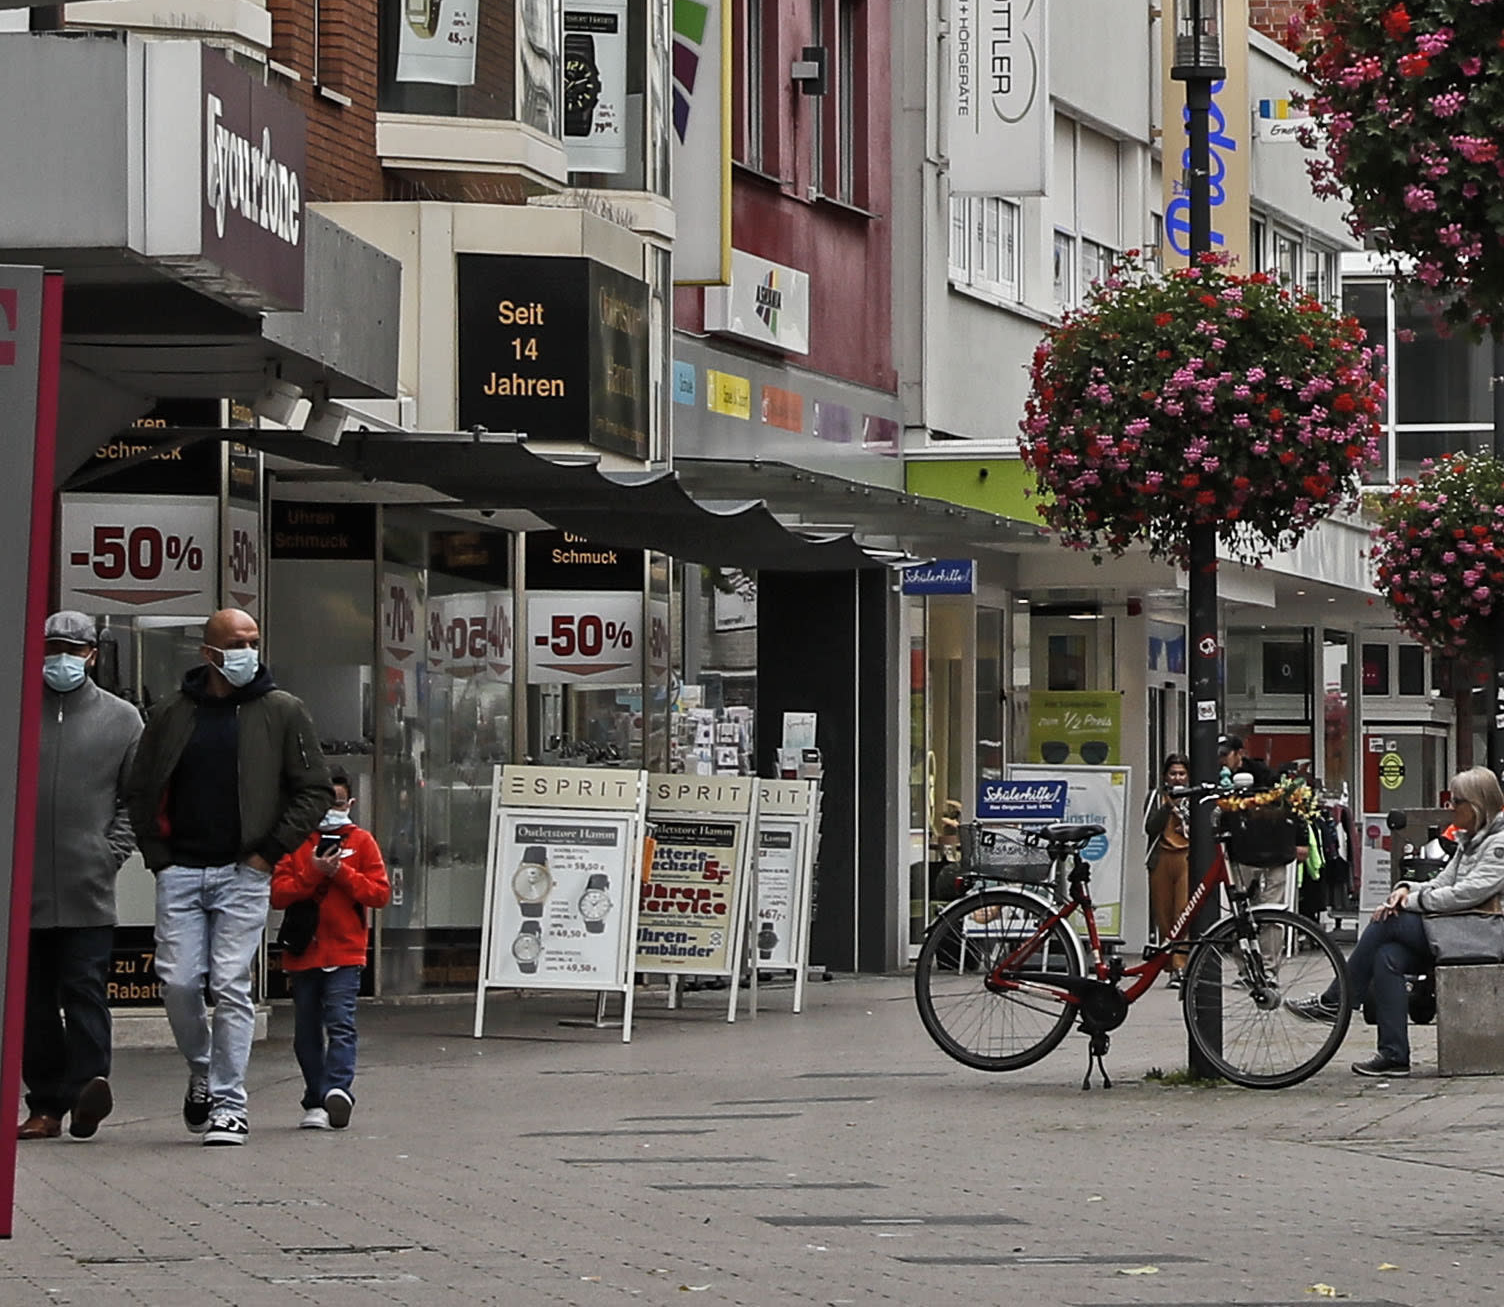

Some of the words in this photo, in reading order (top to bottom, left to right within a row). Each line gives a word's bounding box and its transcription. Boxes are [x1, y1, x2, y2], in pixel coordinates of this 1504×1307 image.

[958, 17, 970, 116] HÖRGERÄTE
[498, 300, 545, 326] Seit
[511, 337, 539, 361] 14
[483, 372, 566, 397] Jahren
[274, 533, 349, 549] Schmuck
[70, 526, 204, 580] -50%
[552, 548, 617, 564] Schmuck
[534, 615, 633, 658] -50%
[511, 776, 628, 797] ESPRIT
[647, 783, 740, 801] SPRIT
[518, 825, 577, 839] Outletstore
[579, 828, 616, 841] Hamm
[700, 825, 733, 837] Hamm
[653, 847, 716, 861] tterie-
[652, 860, 704, 872] echsel
[637, 928, 698, 944] hren-
[637, 944, 715, 958] rmbänder
[115, 960, 136, 974] zu
